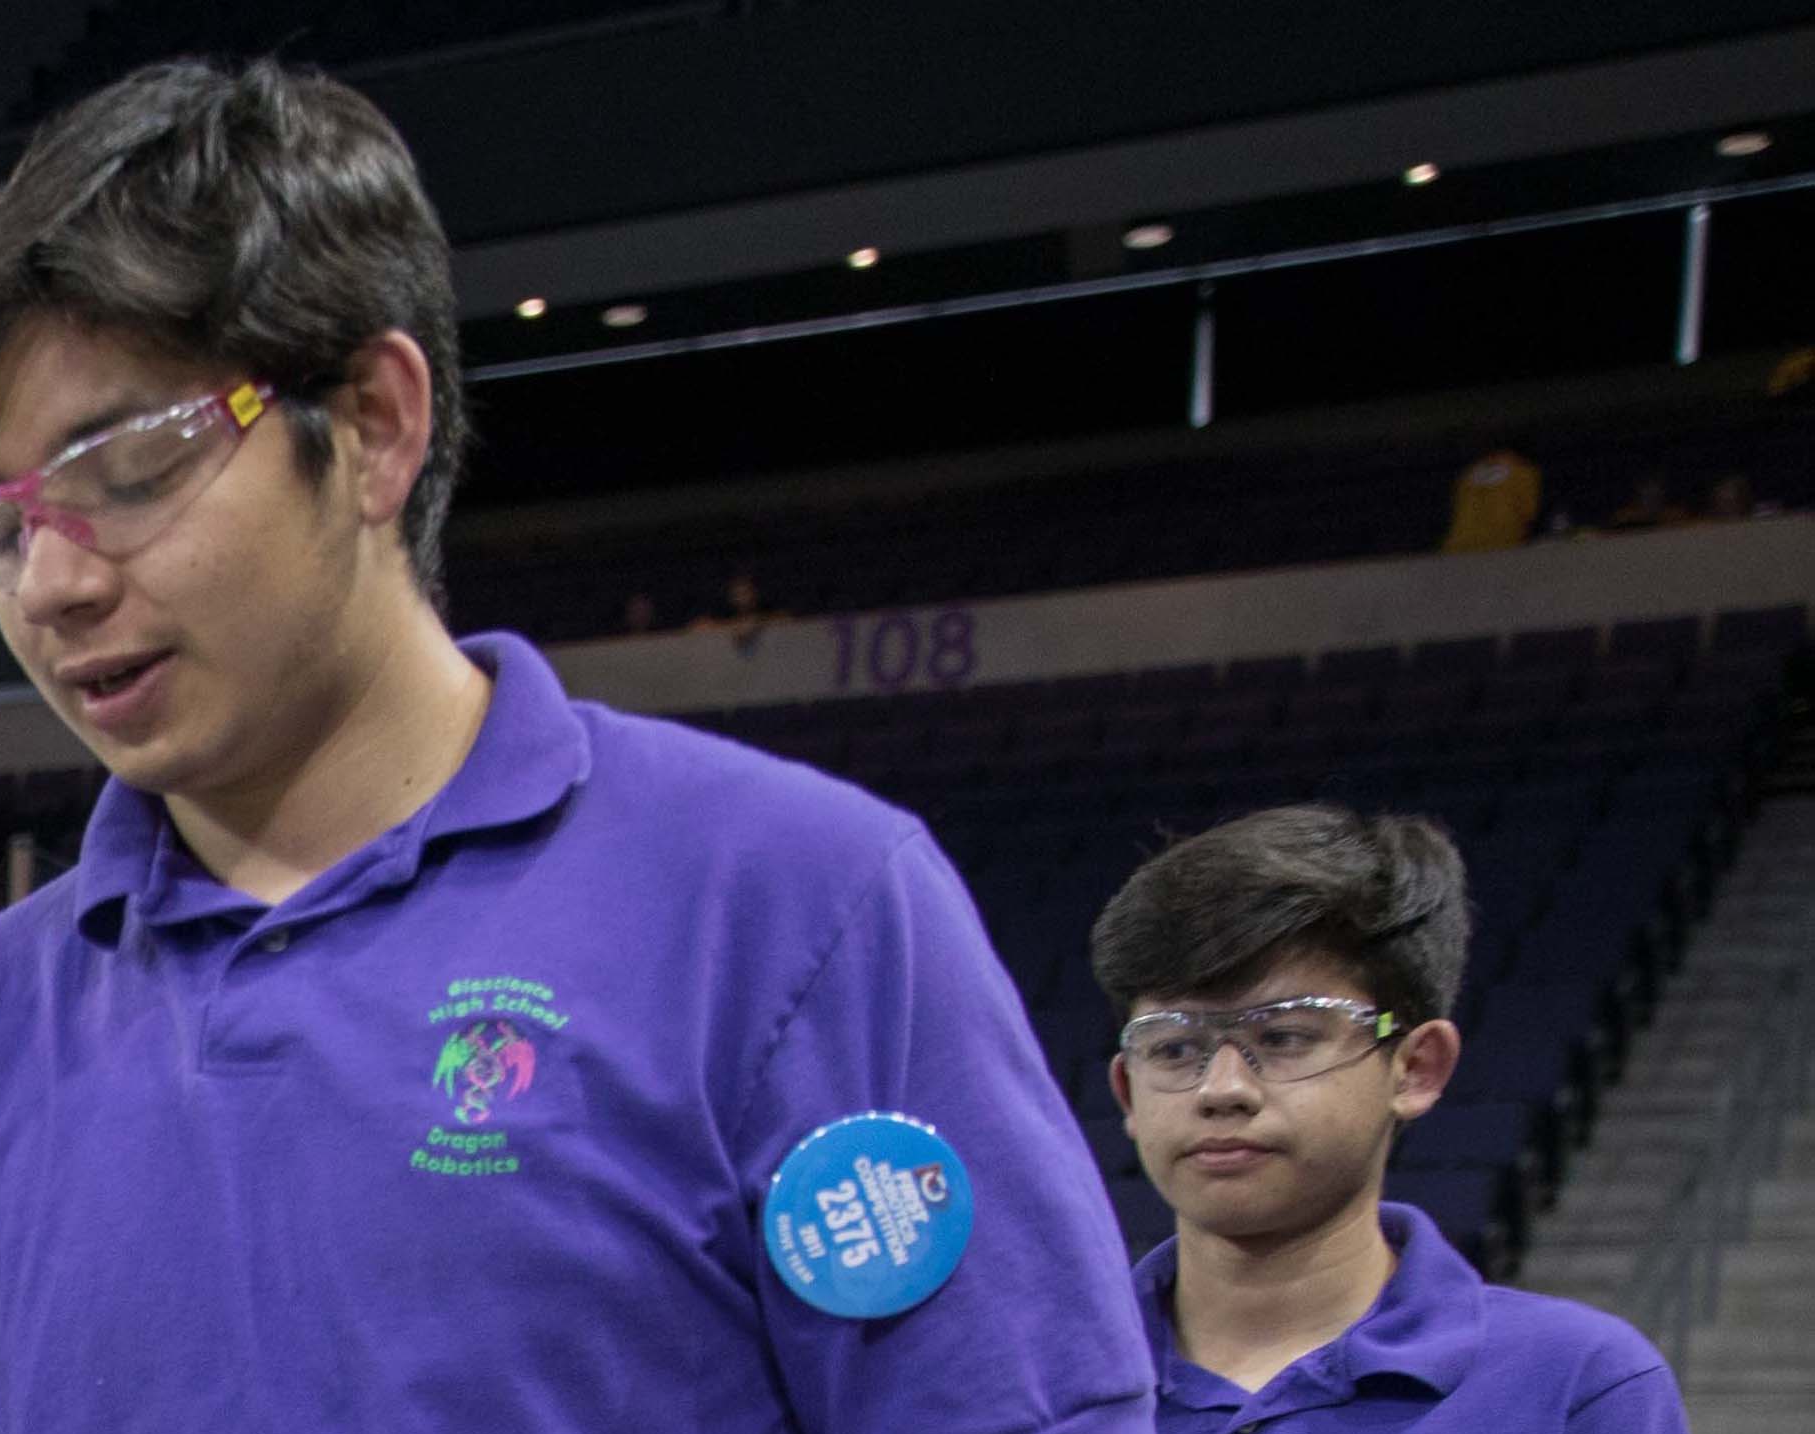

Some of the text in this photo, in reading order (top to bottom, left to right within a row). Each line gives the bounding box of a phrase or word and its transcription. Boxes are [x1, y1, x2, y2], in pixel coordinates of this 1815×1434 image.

[824, 605, 980, 694] 108
[493, 994, 570, 1029] School
[427, 1125, 507, 1154] Dragon
[410, 1148, 519, 1176] Robotics
[816, 1180, 881, 1268] 2375
